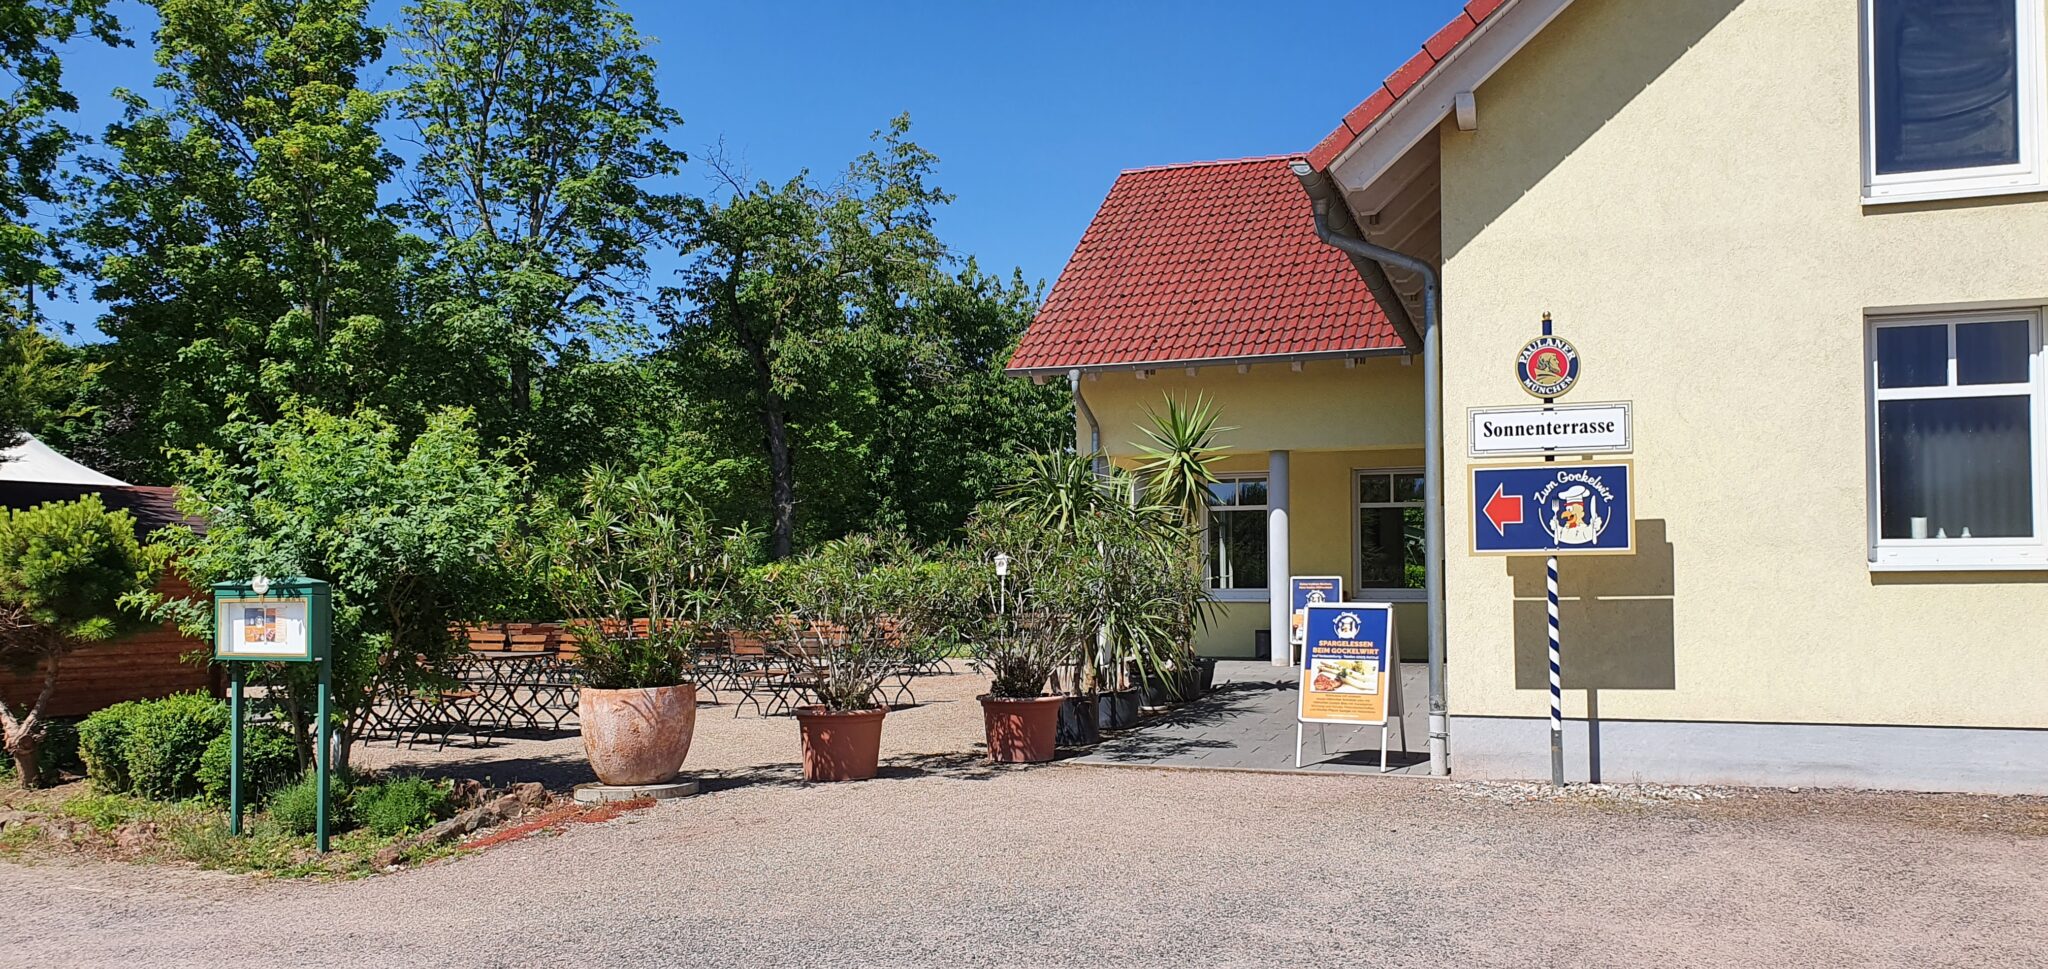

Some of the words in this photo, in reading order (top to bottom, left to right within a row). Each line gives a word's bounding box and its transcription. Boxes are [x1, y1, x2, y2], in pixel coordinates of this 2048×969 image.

[1519, 338, 1576, 363] PAULANER
[1483, 421, 1615, 437] Sonnenterrasse
[1533, 480, 1558, 504] Zum
[1557, 469, 1614, 503] Gockelwirt
